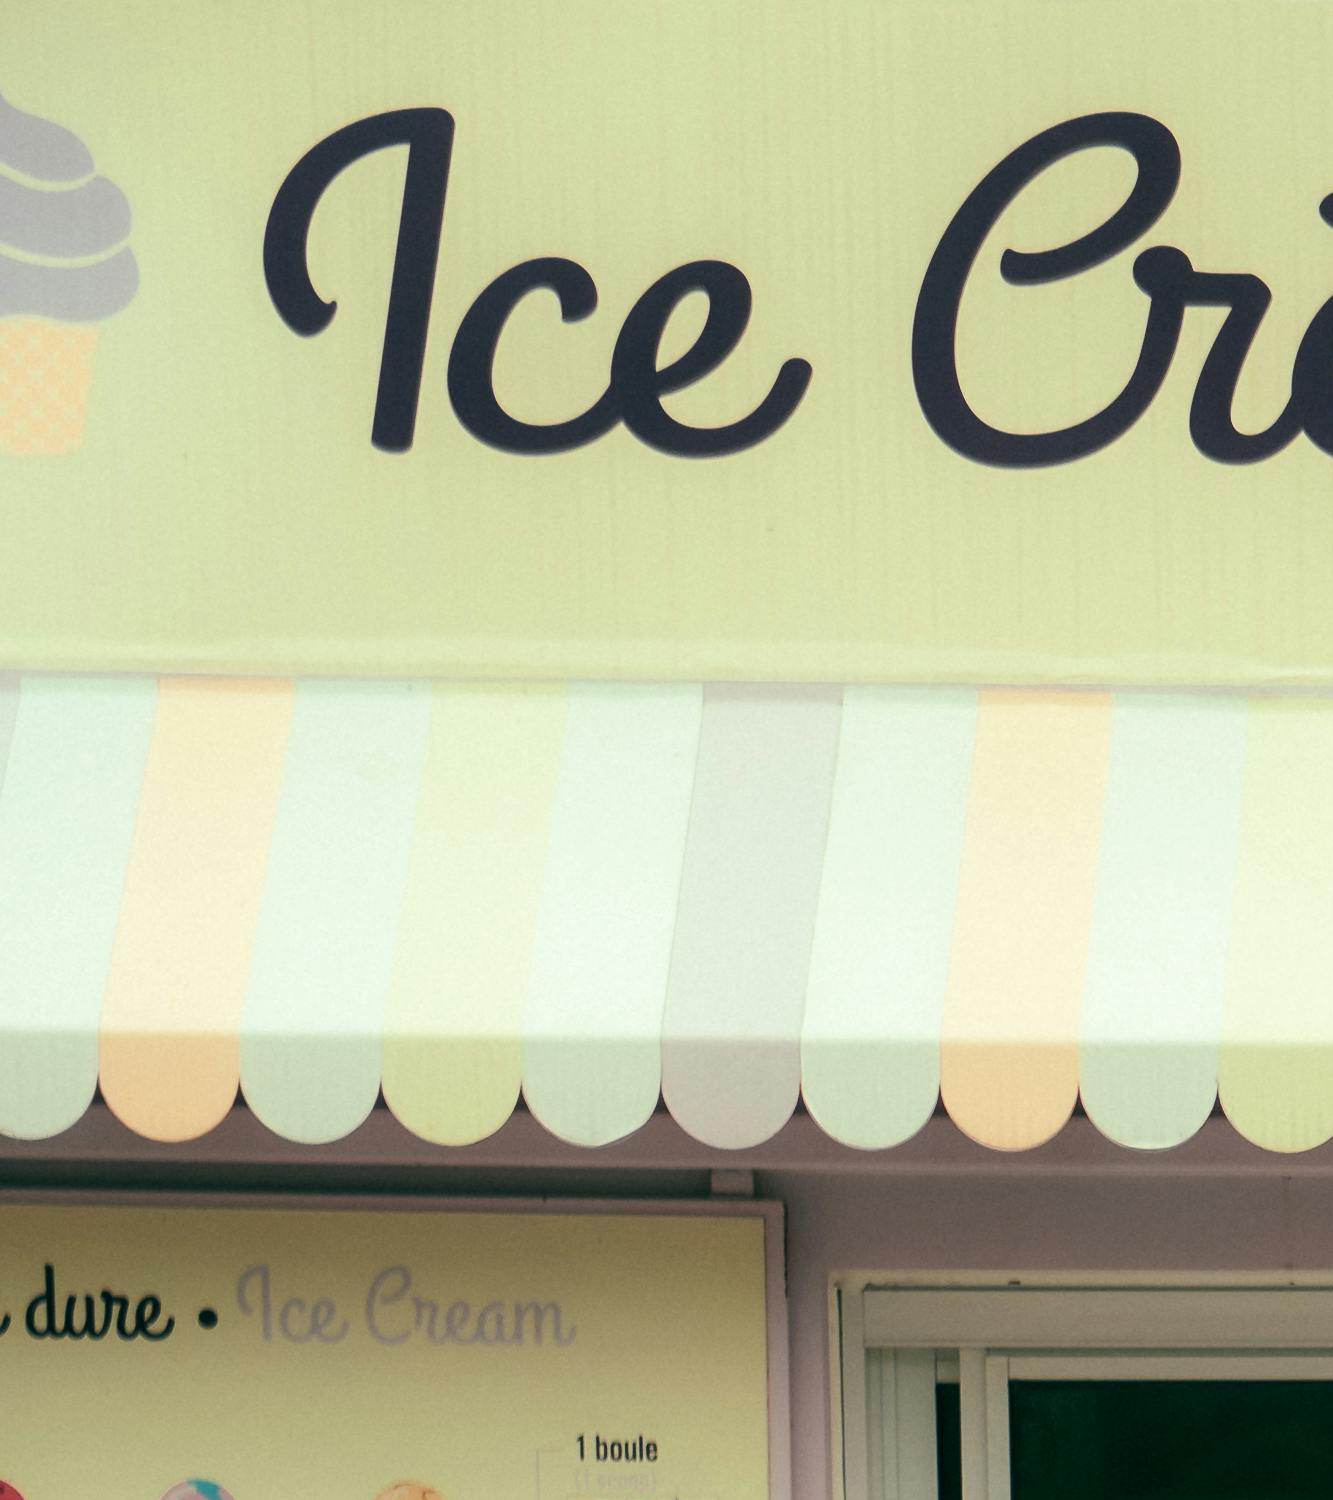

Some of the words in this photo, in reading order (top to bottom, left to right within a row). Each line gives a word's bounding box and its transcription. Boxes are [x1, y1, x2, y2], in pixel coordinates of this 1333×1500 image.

[262, 106, 813, 459] Ice
[25, 1263, 176, 1342] dure
[236, 1265, 349, 1343] Ice
[365, 1264, 577, 1347] Cream
[576, 1434, 585, 1461] 1
[595, 1434, 658, 1462] boule
